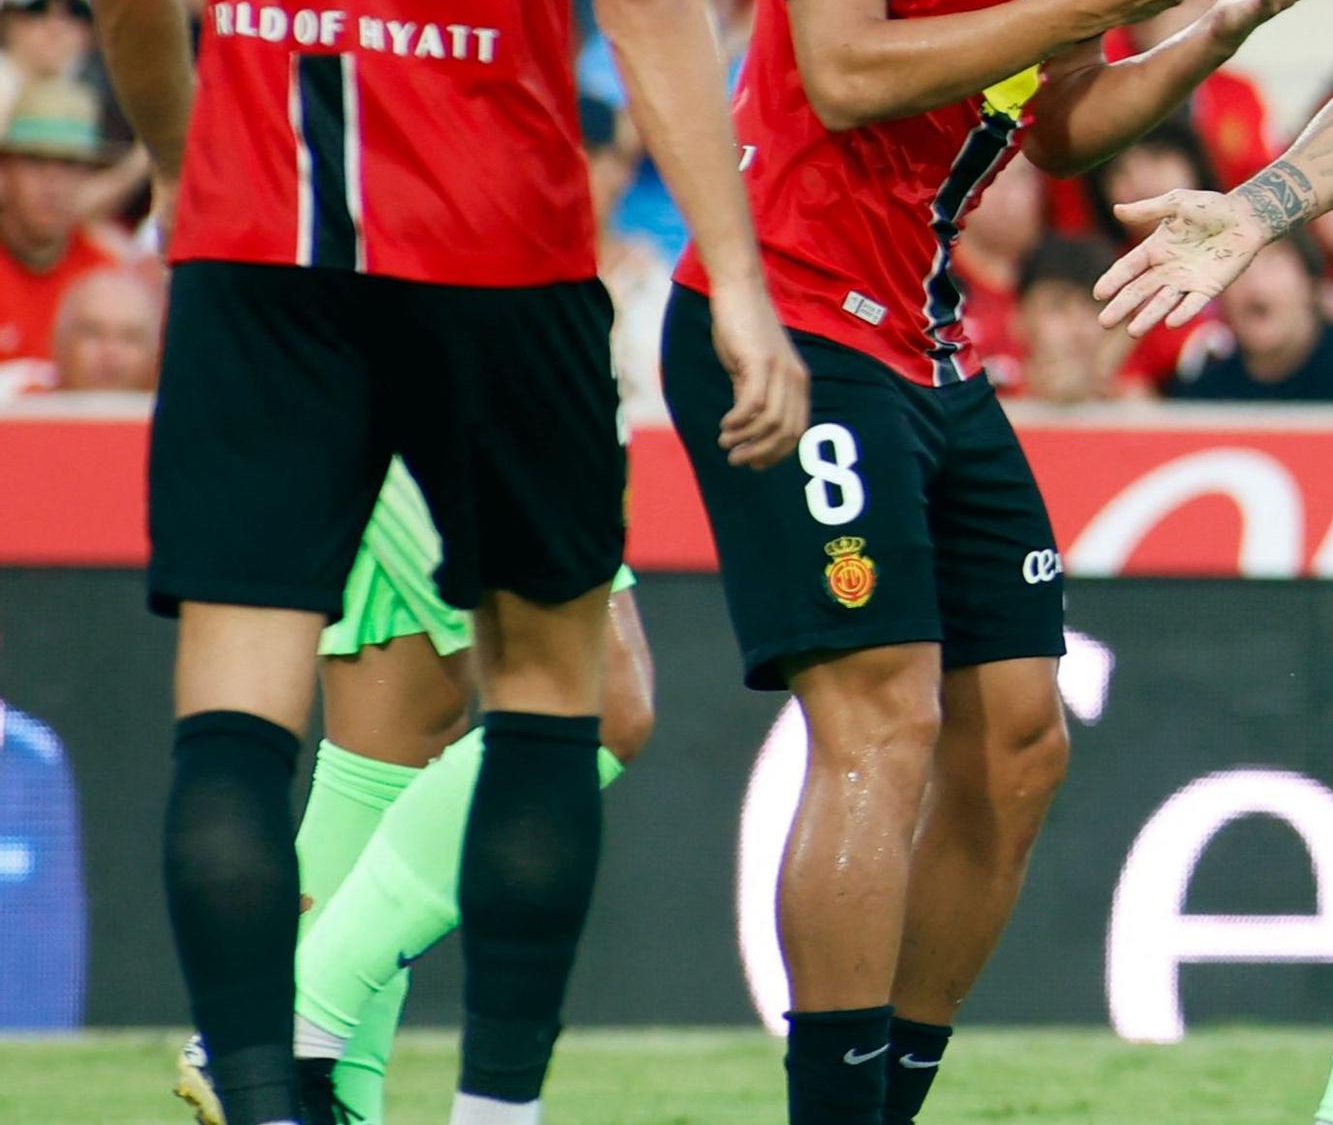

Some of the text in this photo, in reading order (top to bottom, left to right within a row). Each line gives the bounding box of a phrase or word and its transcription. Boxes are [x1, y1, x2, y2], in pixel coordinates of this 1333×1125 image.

[294, 9, 346, 46] OF
[358, 16, 499, 63] HYATT
[798, 422, 866, 526] 8
